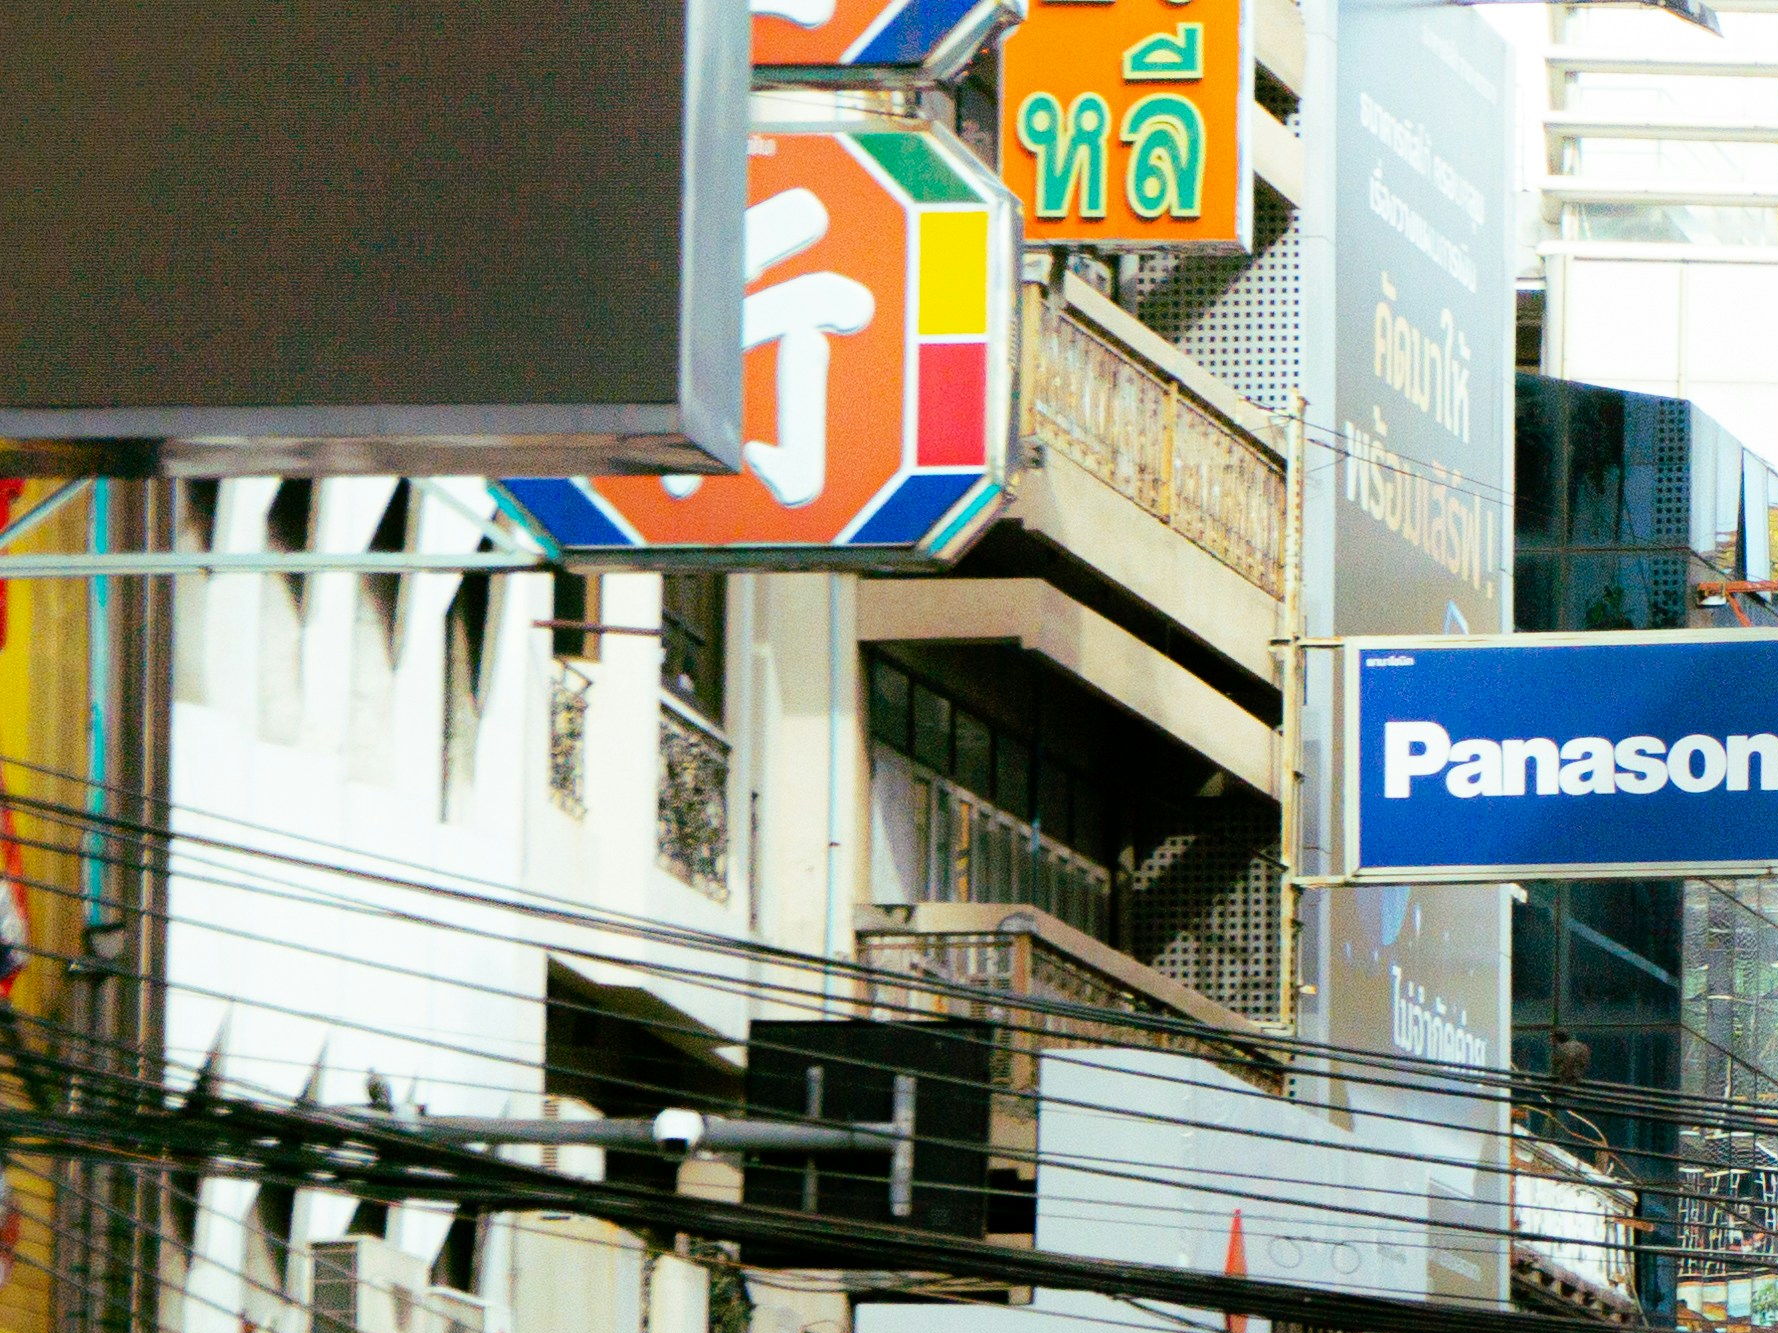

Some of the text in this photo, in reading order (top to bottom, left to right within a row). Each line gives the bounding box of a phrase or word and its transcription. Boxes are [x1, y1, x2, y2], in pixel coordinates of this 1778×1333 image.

[1017, 20, 1205, 220] หลี
[1375, 270, 1470, 443] คัดมาให้
